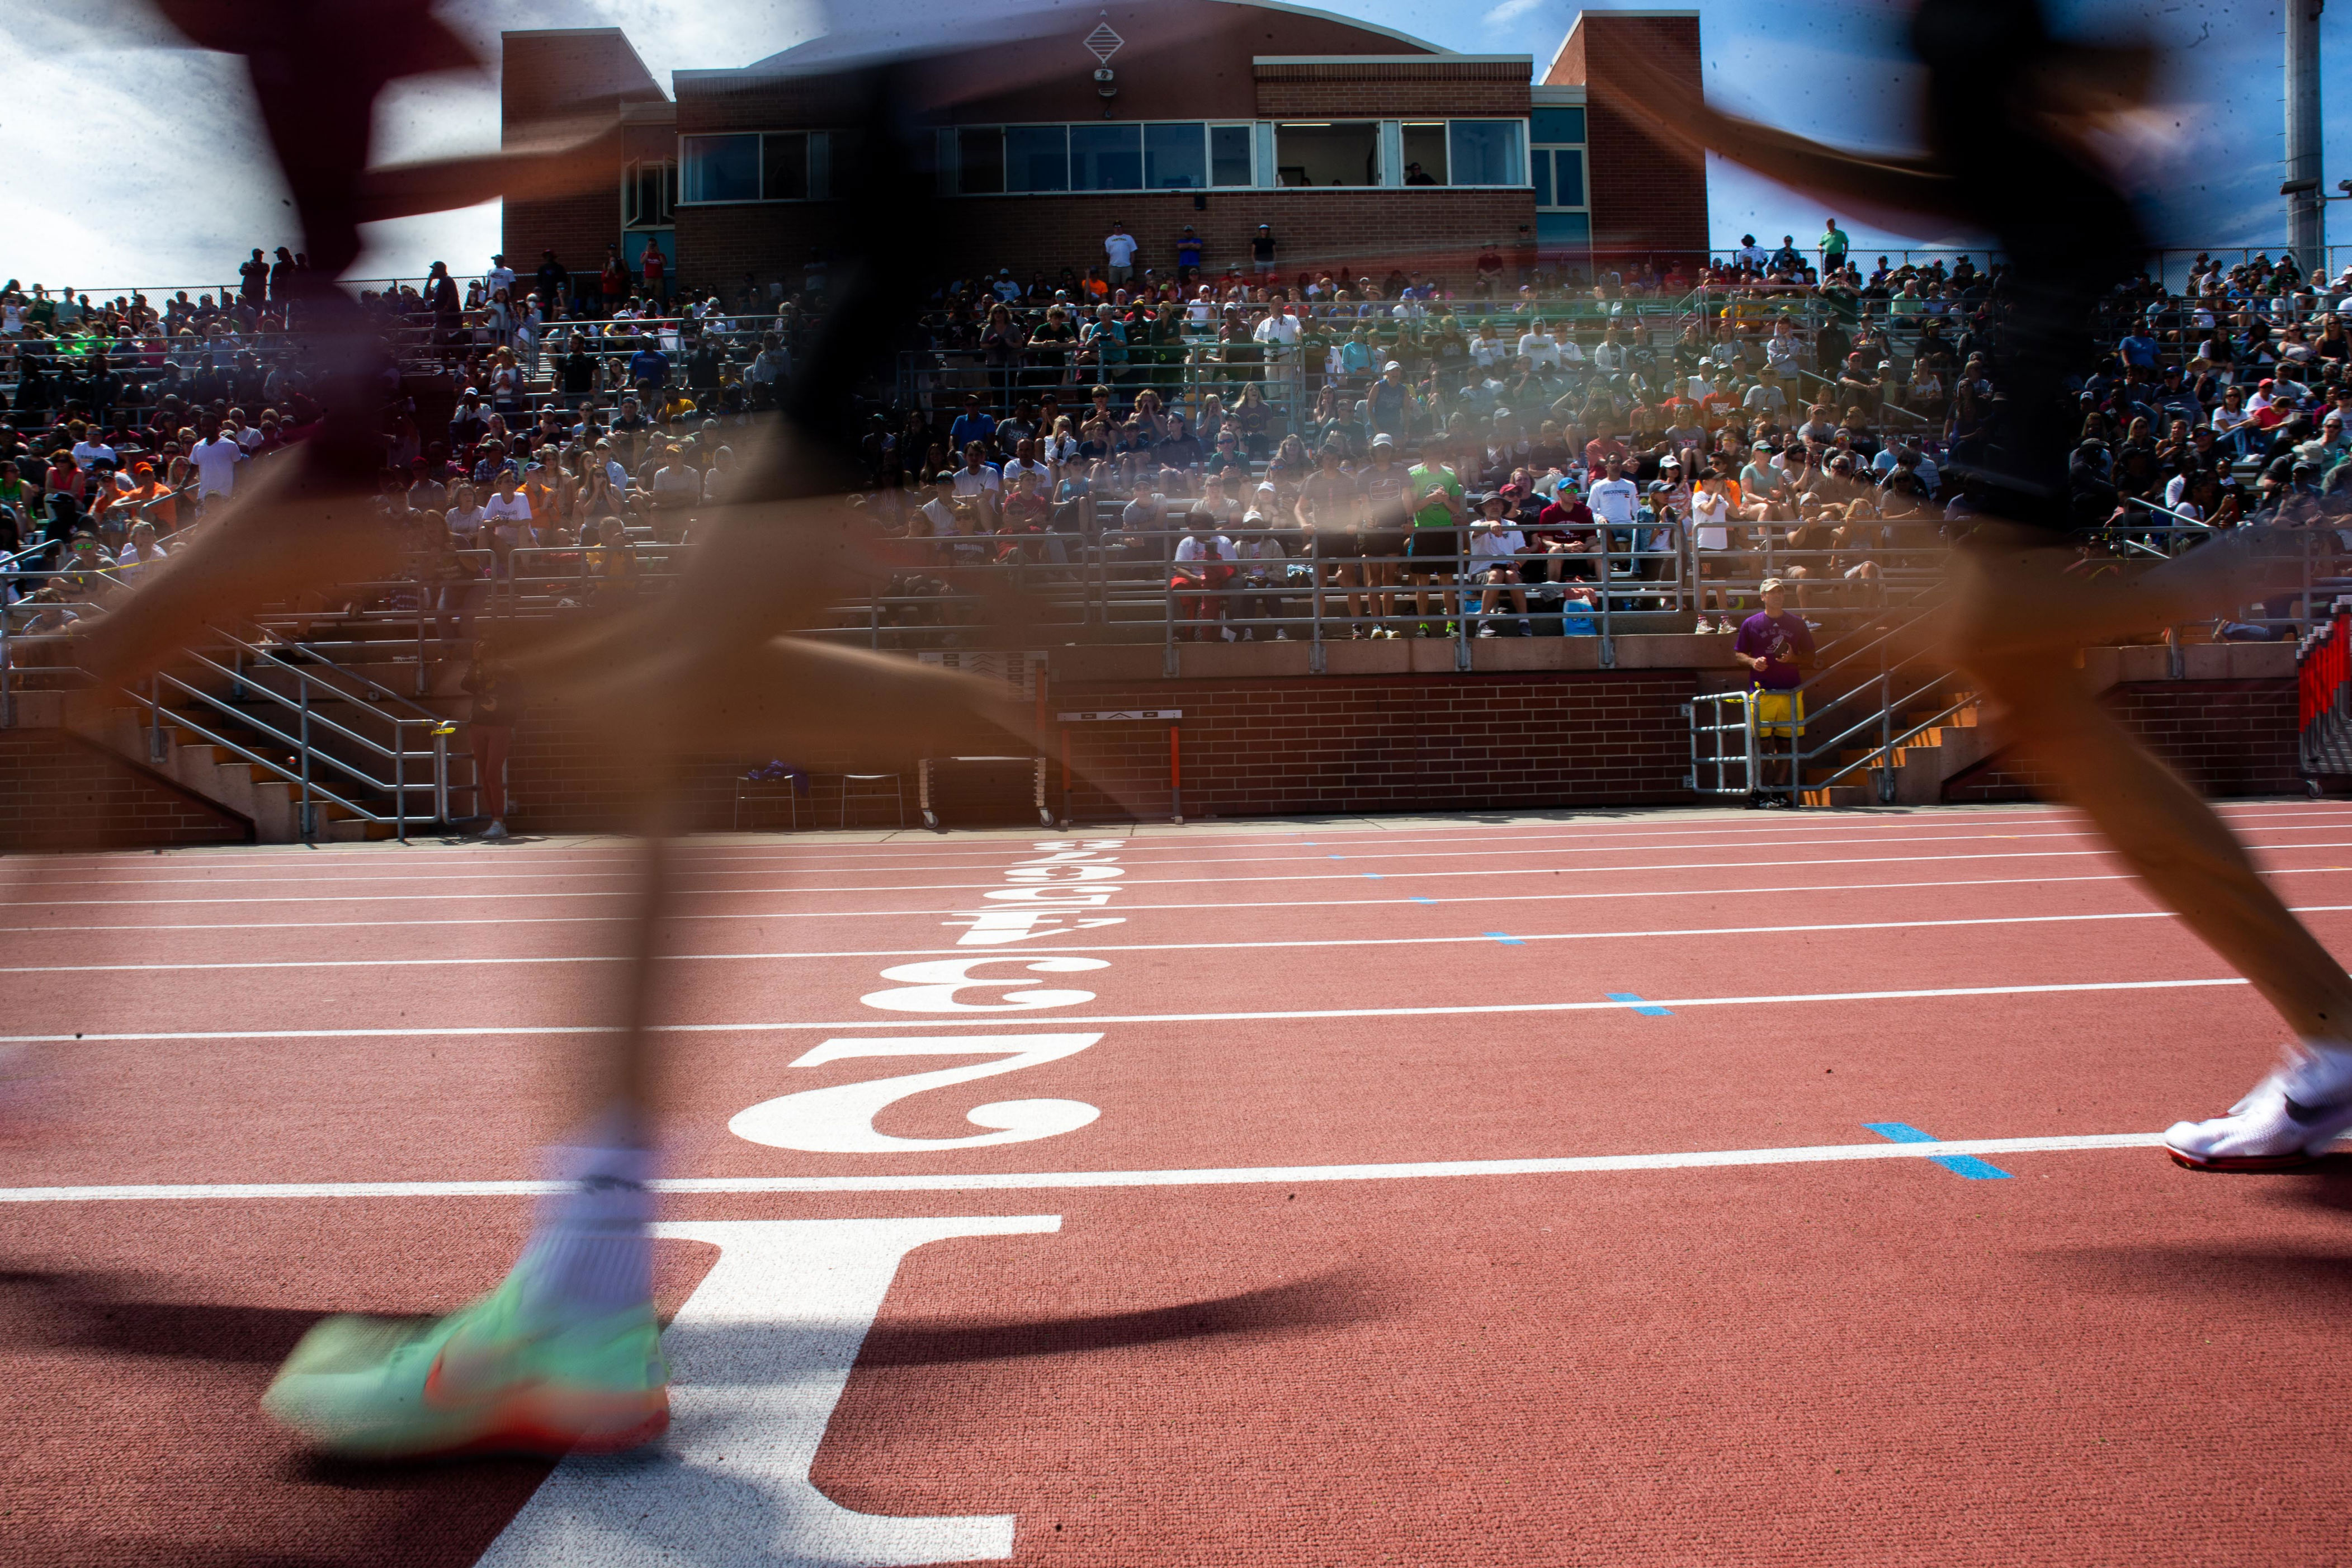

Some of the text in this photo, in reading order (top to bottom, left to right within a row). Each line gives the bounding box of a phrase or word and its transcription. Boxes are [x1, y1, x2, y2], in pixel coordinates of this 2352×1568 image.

[1011, 851, 1120, 865] 7
[1033, 840, 1126, 851] 8
[1004, 866, 1126, 883] 6
[979, 886, 1123, 909] 5
[941, 910, 1127, 945] 4
[859, 956, 1112, 1013] 3
[727, 1032, 1105, 1153] 2
[475, 1214, 1063, 1568] 1
